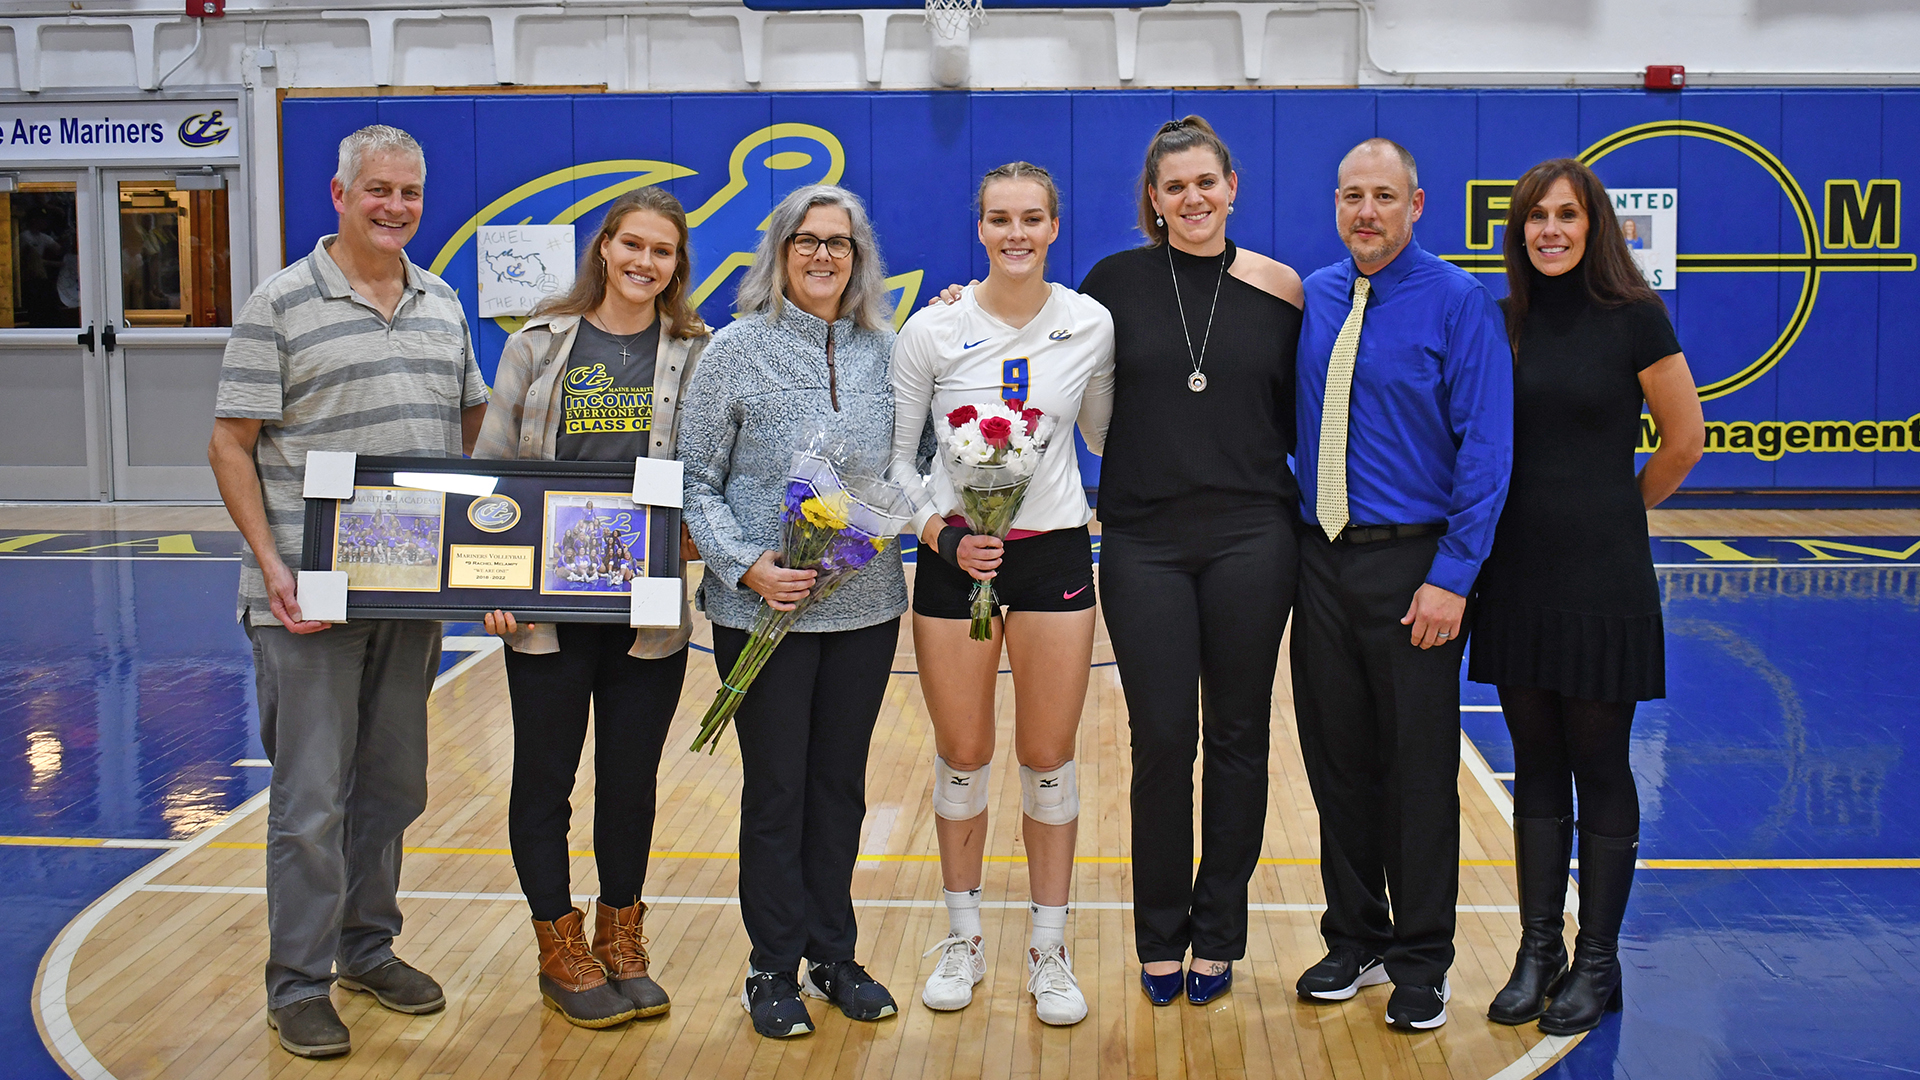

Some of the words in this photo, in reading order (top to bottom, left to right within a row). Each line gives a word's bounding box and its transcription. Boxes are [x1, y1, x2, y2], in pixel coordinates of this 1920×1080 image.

[10, 118, 52, 145] Are
[60, 117, 164, 144] Mariners
[1608, 193, 1674, 209] NTED
[1824, 179, 1901, 249] M
[485, 296, 512, 309] THE
[1000, 356, 1031, 404] 9
[566, 409, 636, 419] EVERYONE
[569, 420, 626, 431] CLASS
[632, 419, 652, 429] OF
[1637, 415, 1920, 459] Mnagement
